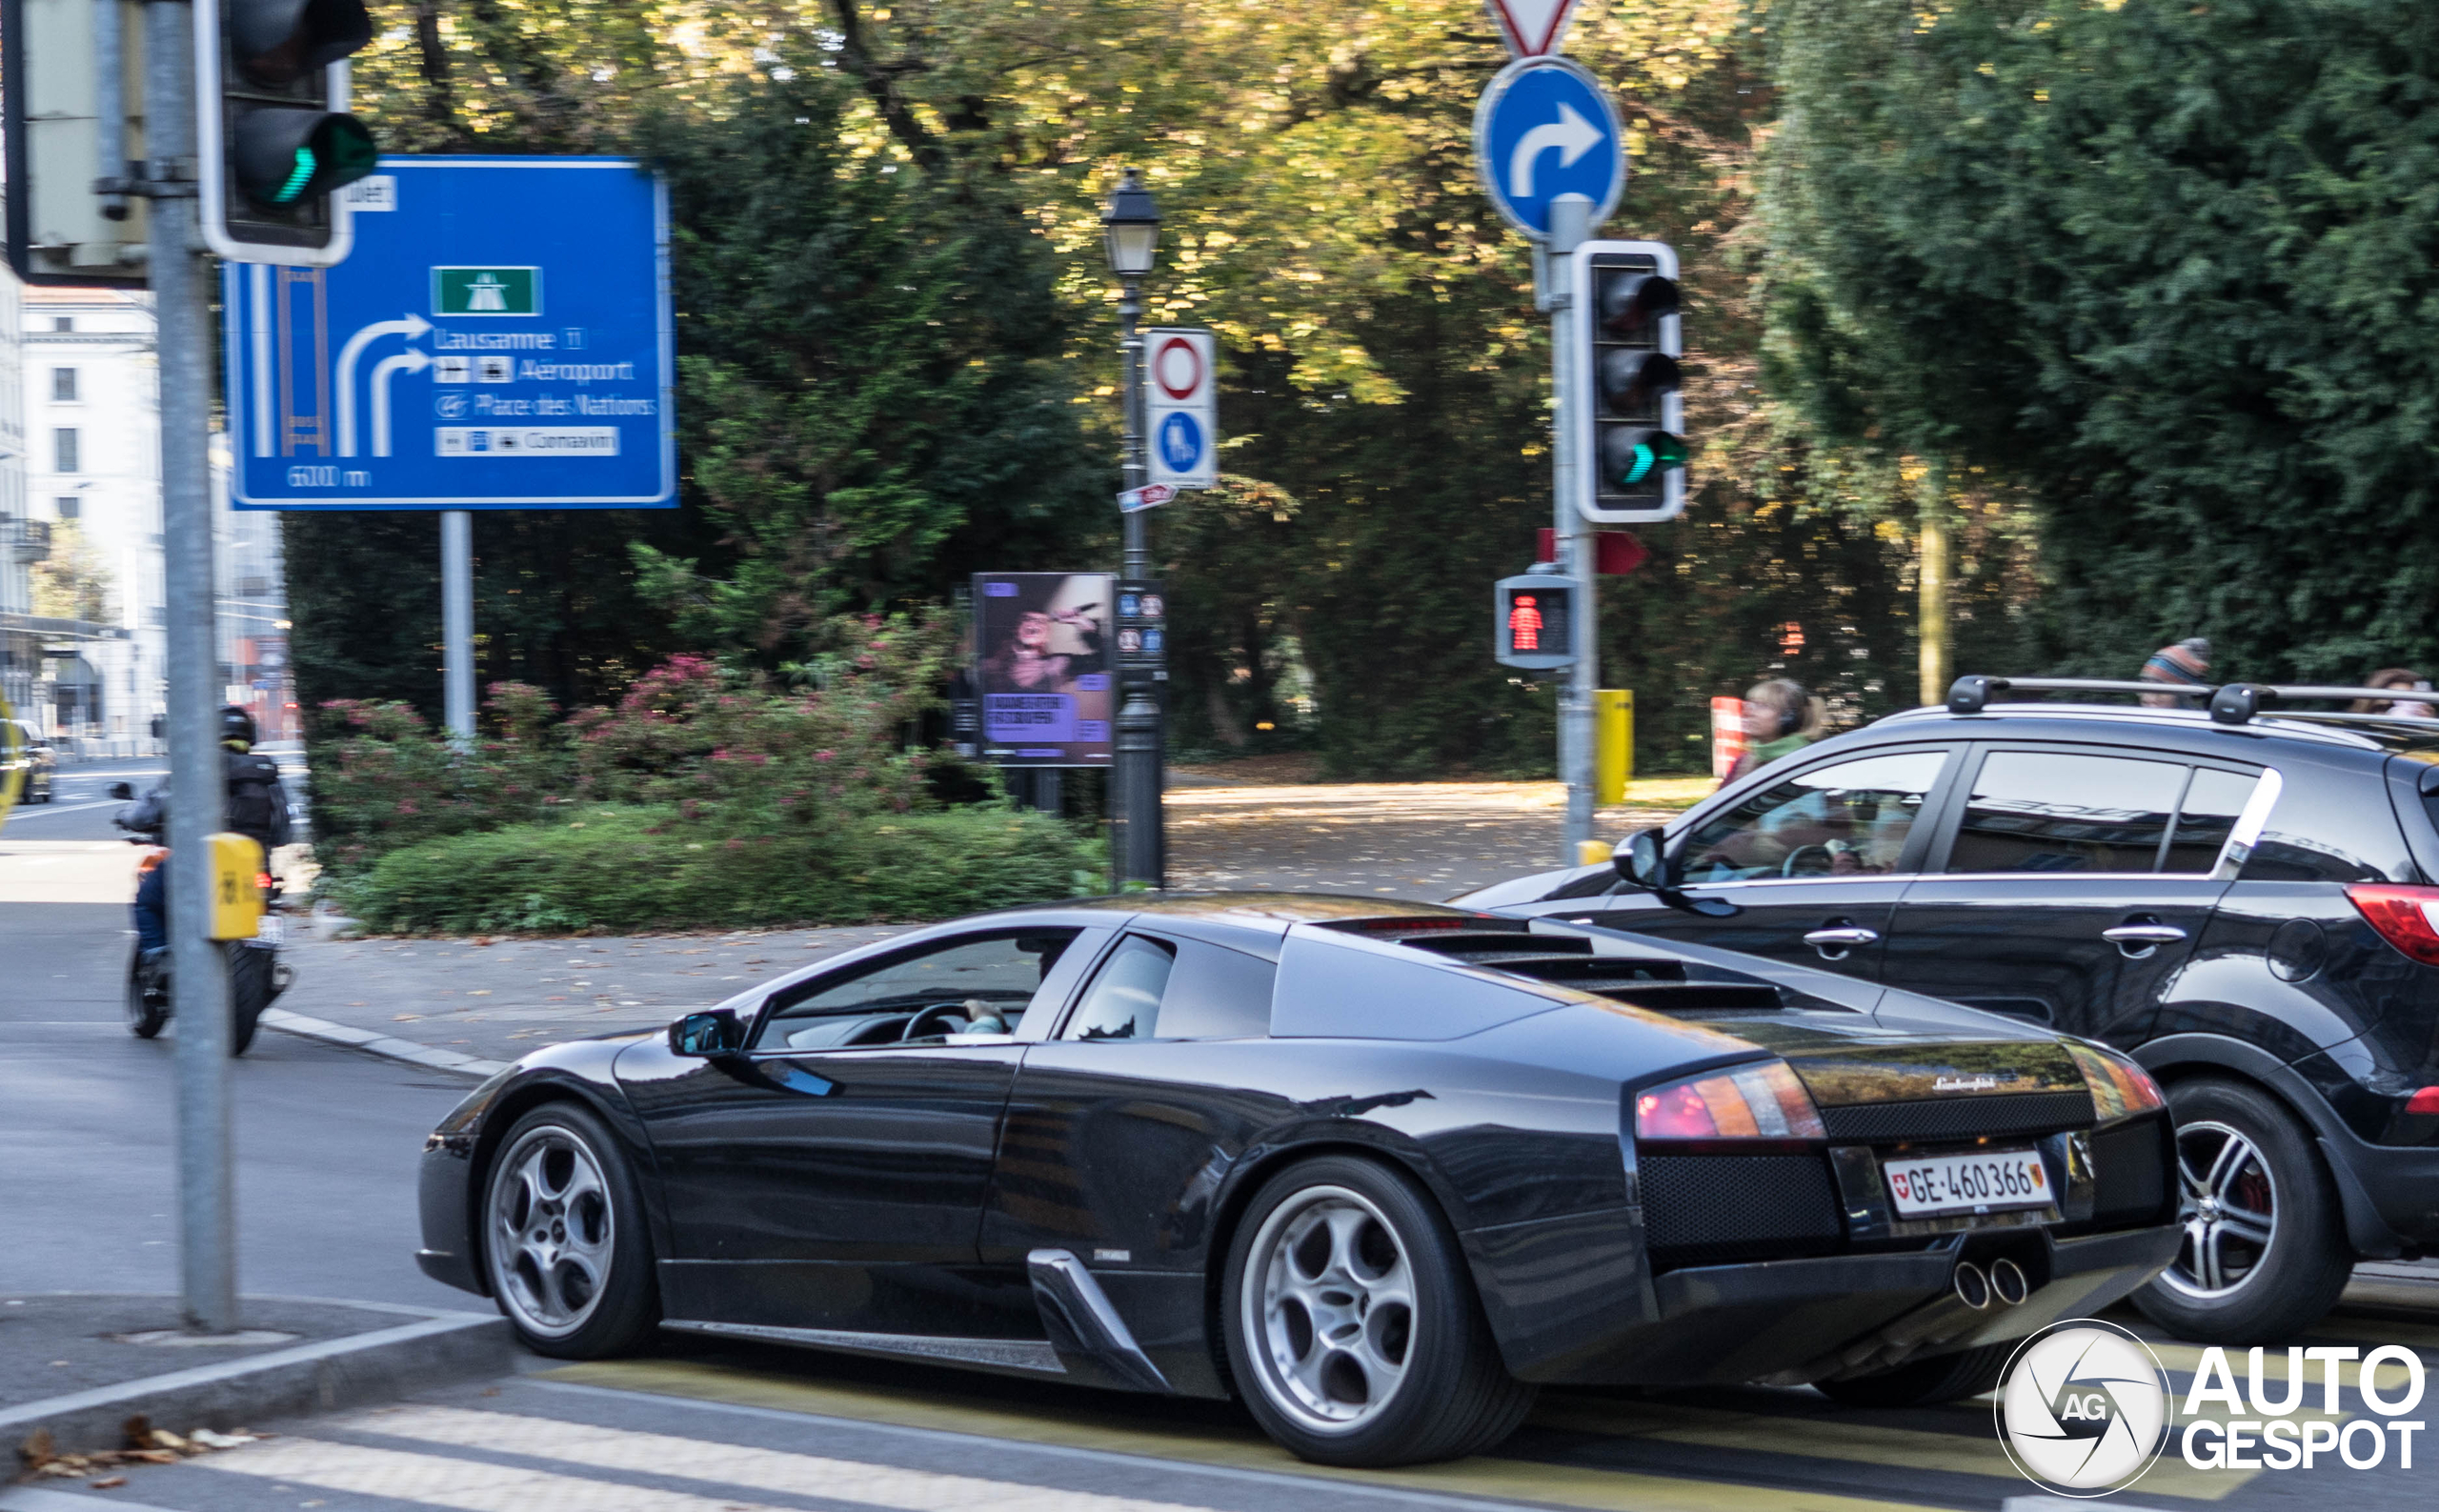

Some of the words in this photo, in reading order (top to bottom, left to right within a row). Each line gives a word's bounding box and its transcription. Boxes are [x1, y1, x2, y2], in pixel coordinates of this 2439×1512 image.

[434, 329, 556, 351] Lausanne
[517, 358, 635, 386] Aéroport
[474, 393, 532, 416] Place
[533, 393, 573, 416] des
[574, 393, 656, 416] Nations
[525, 432, 615, 449] Cornavin
[1932, 1077, 1996, 1092] Lamborghini
